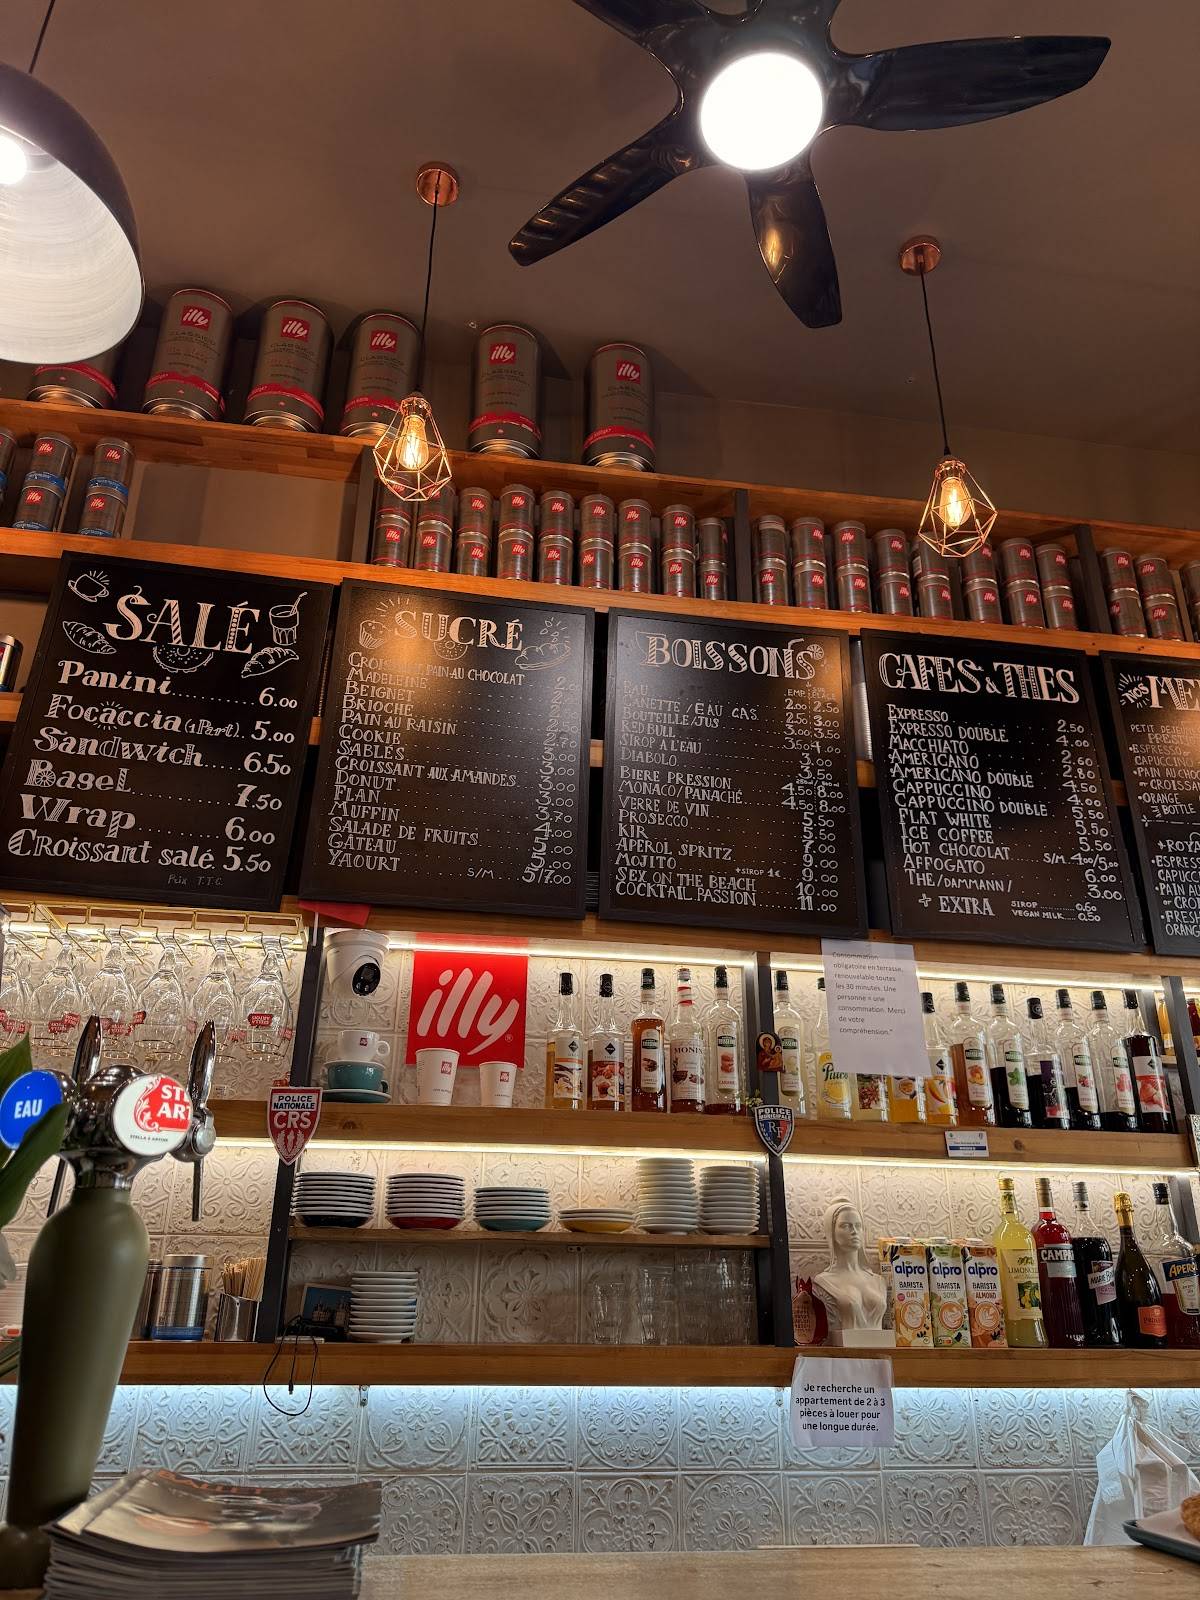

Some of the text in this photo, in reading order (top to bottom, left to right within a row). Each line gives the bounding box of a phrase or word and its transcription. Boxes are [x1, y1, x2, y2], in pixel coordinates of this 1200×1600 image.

[183, 309, 209, 325] illy
[283, 321, 307, 336] illy
[372, 333, 396, 348] illy
[491, 346, 514, 361] illy
[618, 363, 639, 379] illy
[102, 585, 261, 655] SALÉ
[394, 609, 523, 651] SUCRÉ
[644, 632, 818, 680] BOISSONS
[58, 659, 298, 709] Panini 6.00
[468, 668, 526, 686] CHOCOLAT
[345, 681, 415, 702] BEIGNET
[342, 695, 414, 717] BRIOCHE
[44, 693, 296, 744] Focaccia 5.00
[341, 709, 382, 727] PAIN
[384, 716, 402, 730] AU
[886, 703, 1085, 734] EXPRESSO 2.50
[338, 723, 401, 746] COOKIE
[890, 718, 1089, 748] EXPRESSO DOUBLE 4.00
[33, 726, 292, 776] Sandwich 6.50
[889, 733, 1094, 767] MACCHIATO 2.60
[335, 756, 518, 788] CROISSANT AMANDES
[889, 749, 1097, 781] AMERICANO 2.80
[335, 770, 397, 791] DONUT
[667, 771, 732, 790] PRESSION
[890, 763, 1098, 795] AMERICANO DOUBLE 4.50
[234, 783, 283, 811] 7.50
[333, 784, 381, 803] FLAN
[892, 779, 1102, 808] CAPPUCCINO 4.00
[328, 801, 401, 822] MUFFIN
[619, 794, 661, 813] VERRE
[685, 803, 711, 818] VIN
[895, 793, 1105, 821] CAPPUCCINO DOUBLE 5.50
[1161, 804, 1196, 816] BOTTLE
[19, 793, 276, 845] Wrap 6.00
[619, 808, 689, 828] PROSECCO
[899, 808, 1110, 839] FLAT WHITE 5.50
[329, 816, 480, 847] SALADE DE FRUITS
[618, 822, 649, 839] KIR
[900, 822, 1113, 853] ICE COFFEE 5.50
[222, 845, 272, 873] 5.50
[616, 837, 732, 861] APEROL SPRITZ
[902, 838, 1010, 861] HOT CHOCOLAT
[328, 849, 401, 872] YAOURT
[615, 852, 676, 870] MOJITO
[904, 853, 1117, 884] AFFOGATO 6.00
[616, 866, 648, 884] SEX
[653, 871, 675, 885] ON
[677, 873, 705, 888] THE
[709, 874, 757, 891] BEACH
[615, 881, 694, 901] COCKTAIL
[697, 889, 758, 907] PASSION
[1087, 884, 1123, 901] 3.00
[938, 895, 997, 917] EXTRA
[416, 967, 520, 1056] illy
[14, 1099, 42, 1120] EAU
[273, 1102, 316, 1110] NATIONALE
[758, 1107, 792, 1116] POLICE
[273, 1111, 312, 1129] CRS
[895, 1261, 925, 1278] alpro
[932, 1262, 962, 1279] alpro
[968, 1262, 998, 1278] alpro
[899, 1281, 924, 1289] BARISTA
[937, 1282, 961, 1290] BARISTA
[973, 1282, 998, 1290] BARISTA
[804, 1383, 875, 1394] Je recherche un
[795, 1397, 852, 1406] appartement
[854, 1398, 865, 1406] de
[873, 1398, 879, 1406] à
[800, 1408, 881, 1420] pièces à louer pour
[802, 1422, 879, 1433] une longue durée.
